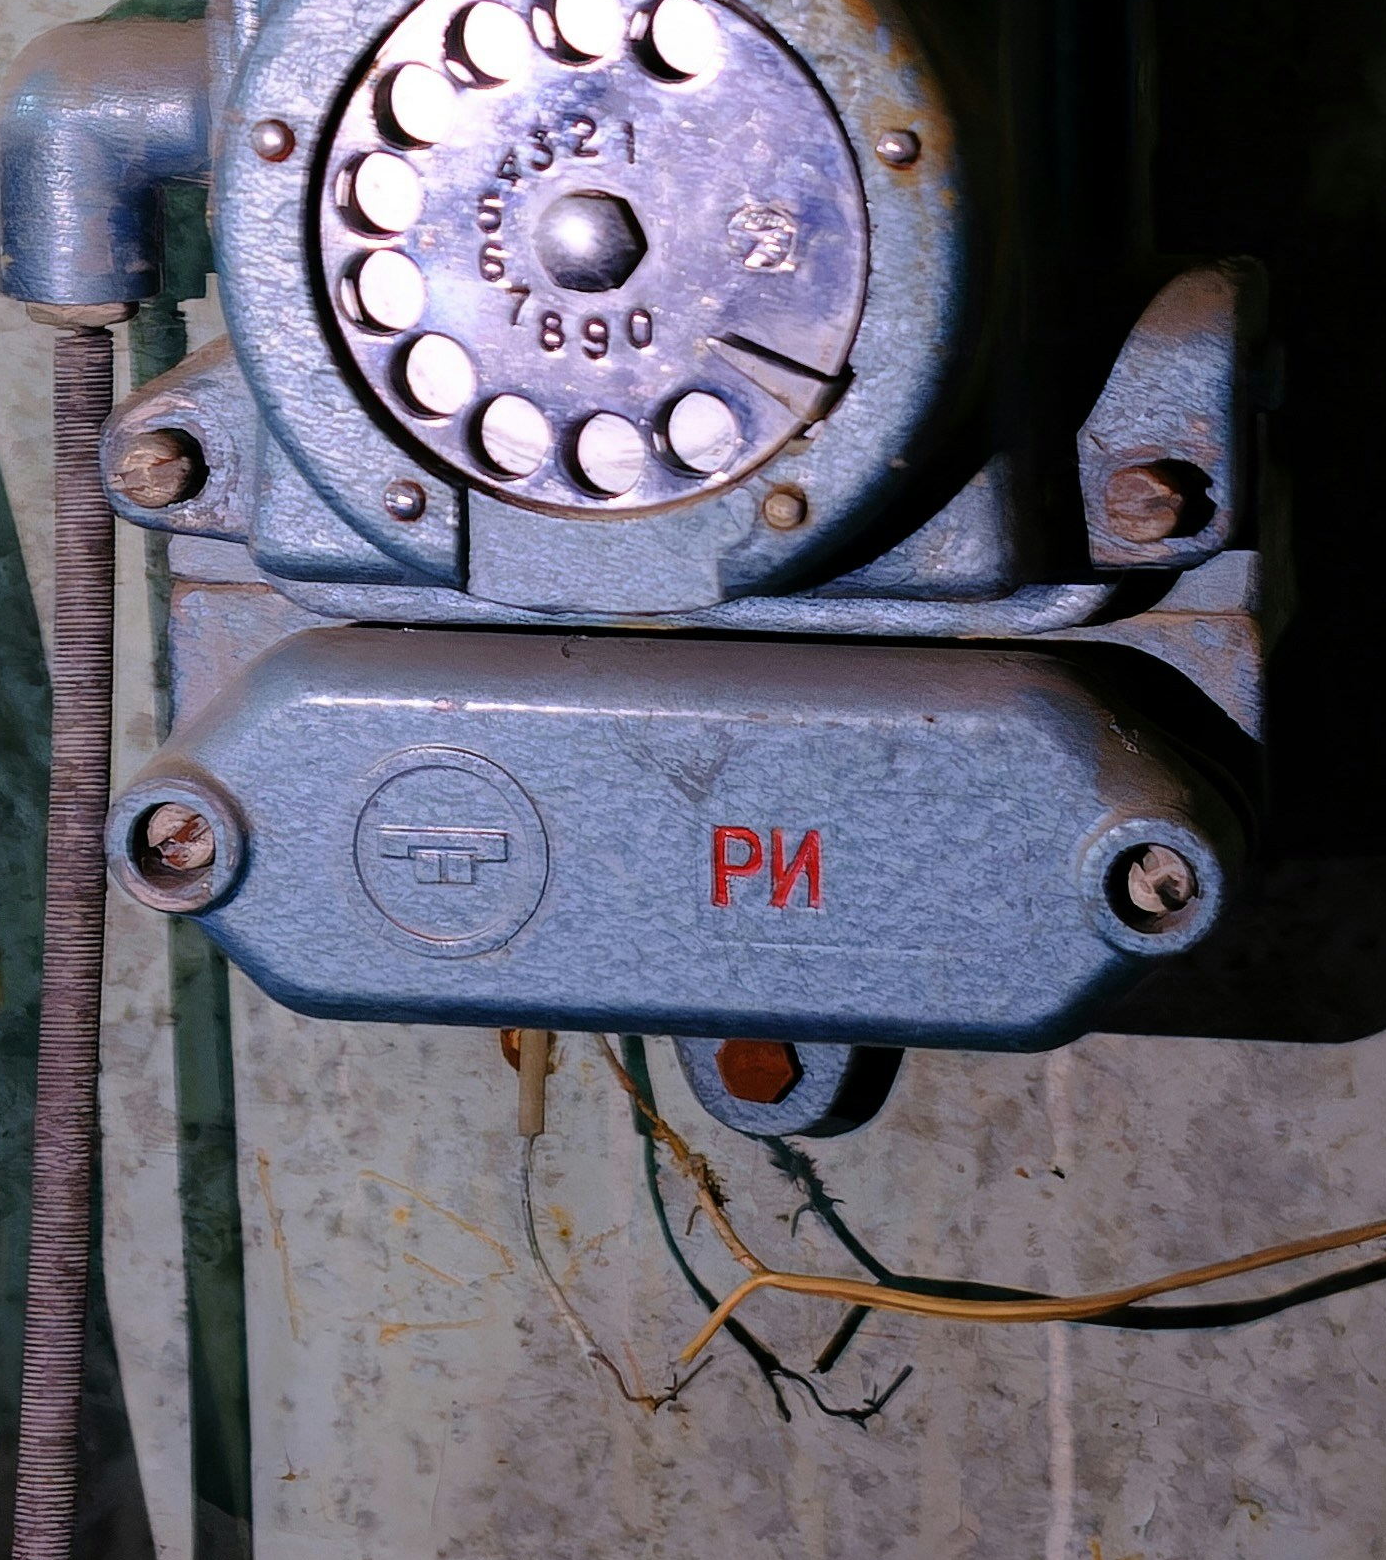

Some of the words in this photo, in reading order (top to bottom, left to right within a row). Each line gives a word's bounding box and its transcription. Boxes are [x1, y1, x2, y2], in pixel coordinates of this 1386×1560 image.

[570, 114, 599, 158] 2
[623, 120, 636, 165] 1
[505, 285, 531, 326] 7
[539, 310, 566, 352] 8
[580, 316, 610, 360] 9
[628, 307, 654, 350] 0
[711, 824, 821, 909] РИ
